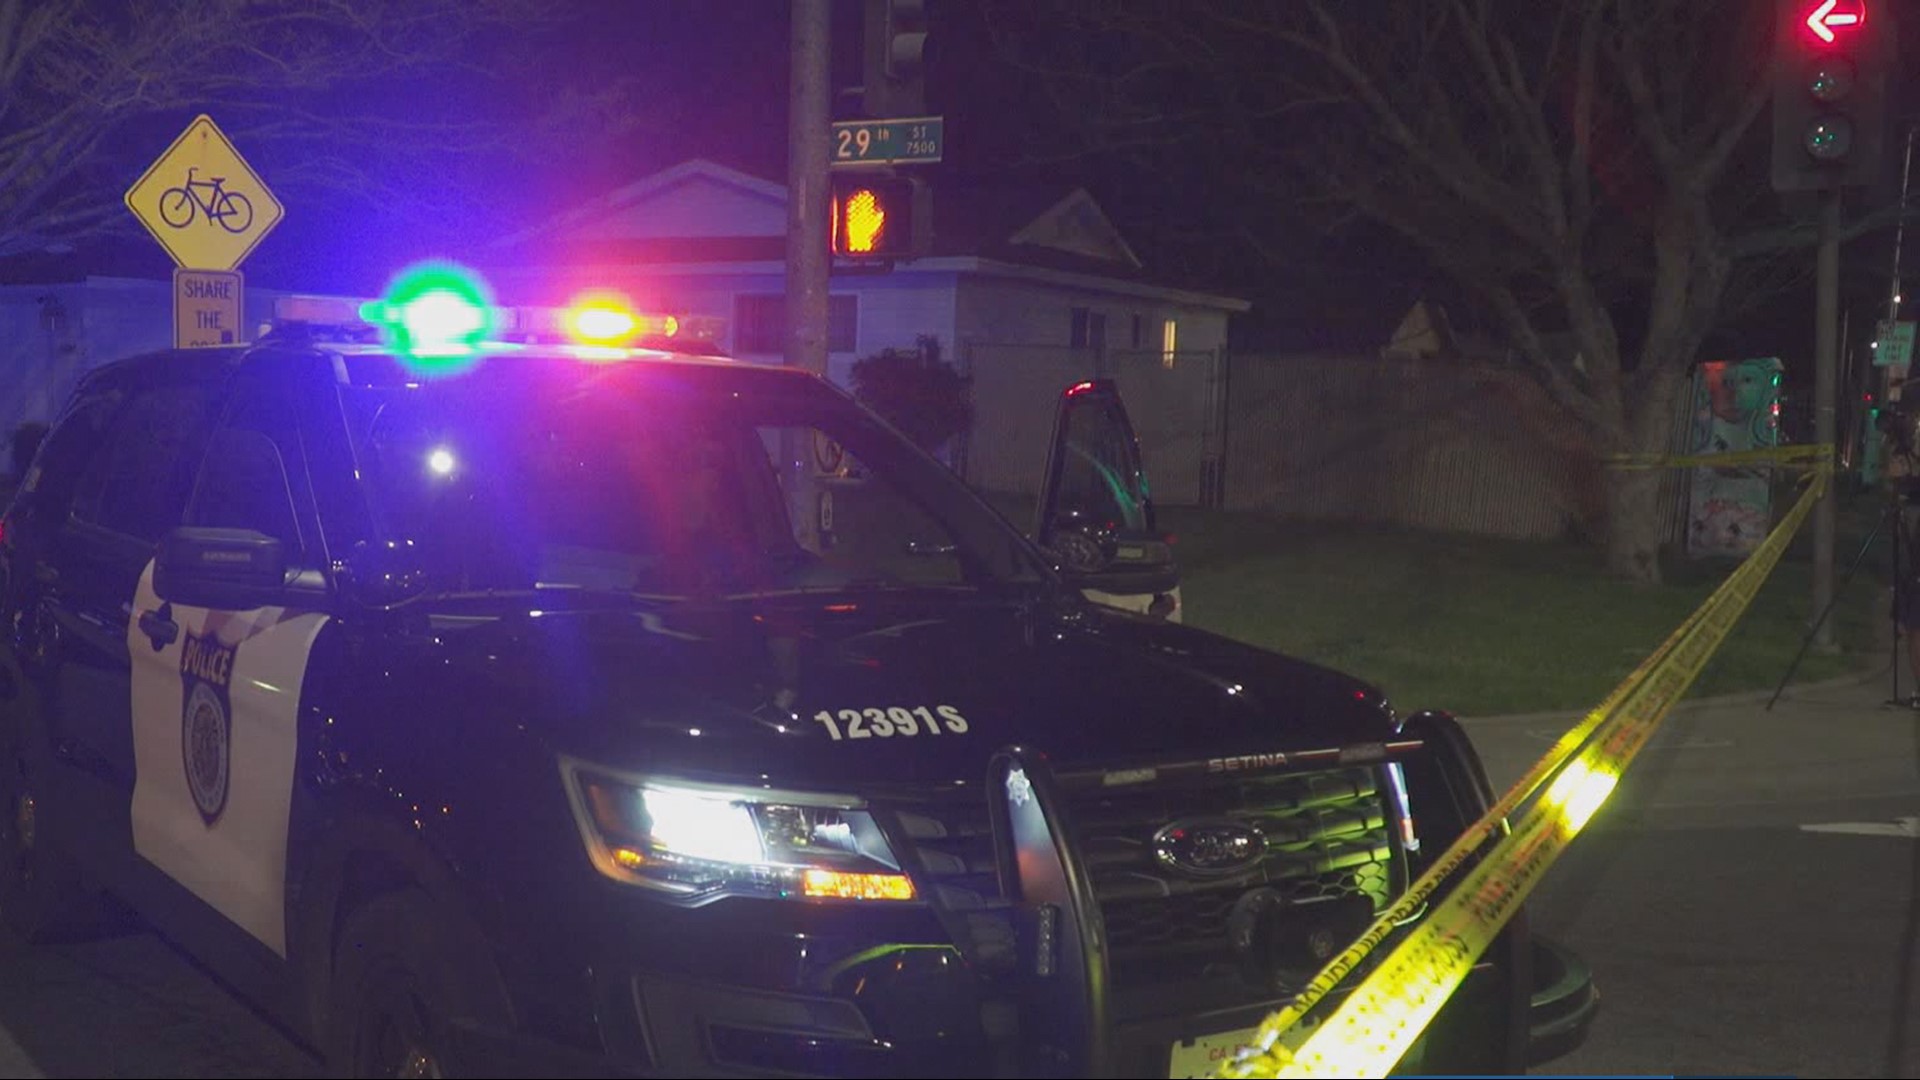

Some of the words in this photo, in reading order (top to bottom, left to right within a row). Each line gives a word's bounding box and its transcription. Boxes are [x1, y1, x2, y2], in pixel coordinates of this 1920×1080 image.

[912, 126, 927, 139] ST
[837, 129, 870, 157] 29
[906, 140, 936, 154] 7500
[184, 279, 233, 299] SHARE
[196, 310, 223, 329] THE
[183, 638, 231, 685] POLICE
[814, 705, 969, 740] 12391S
[1208, 752, 1288, 773] SETINA
